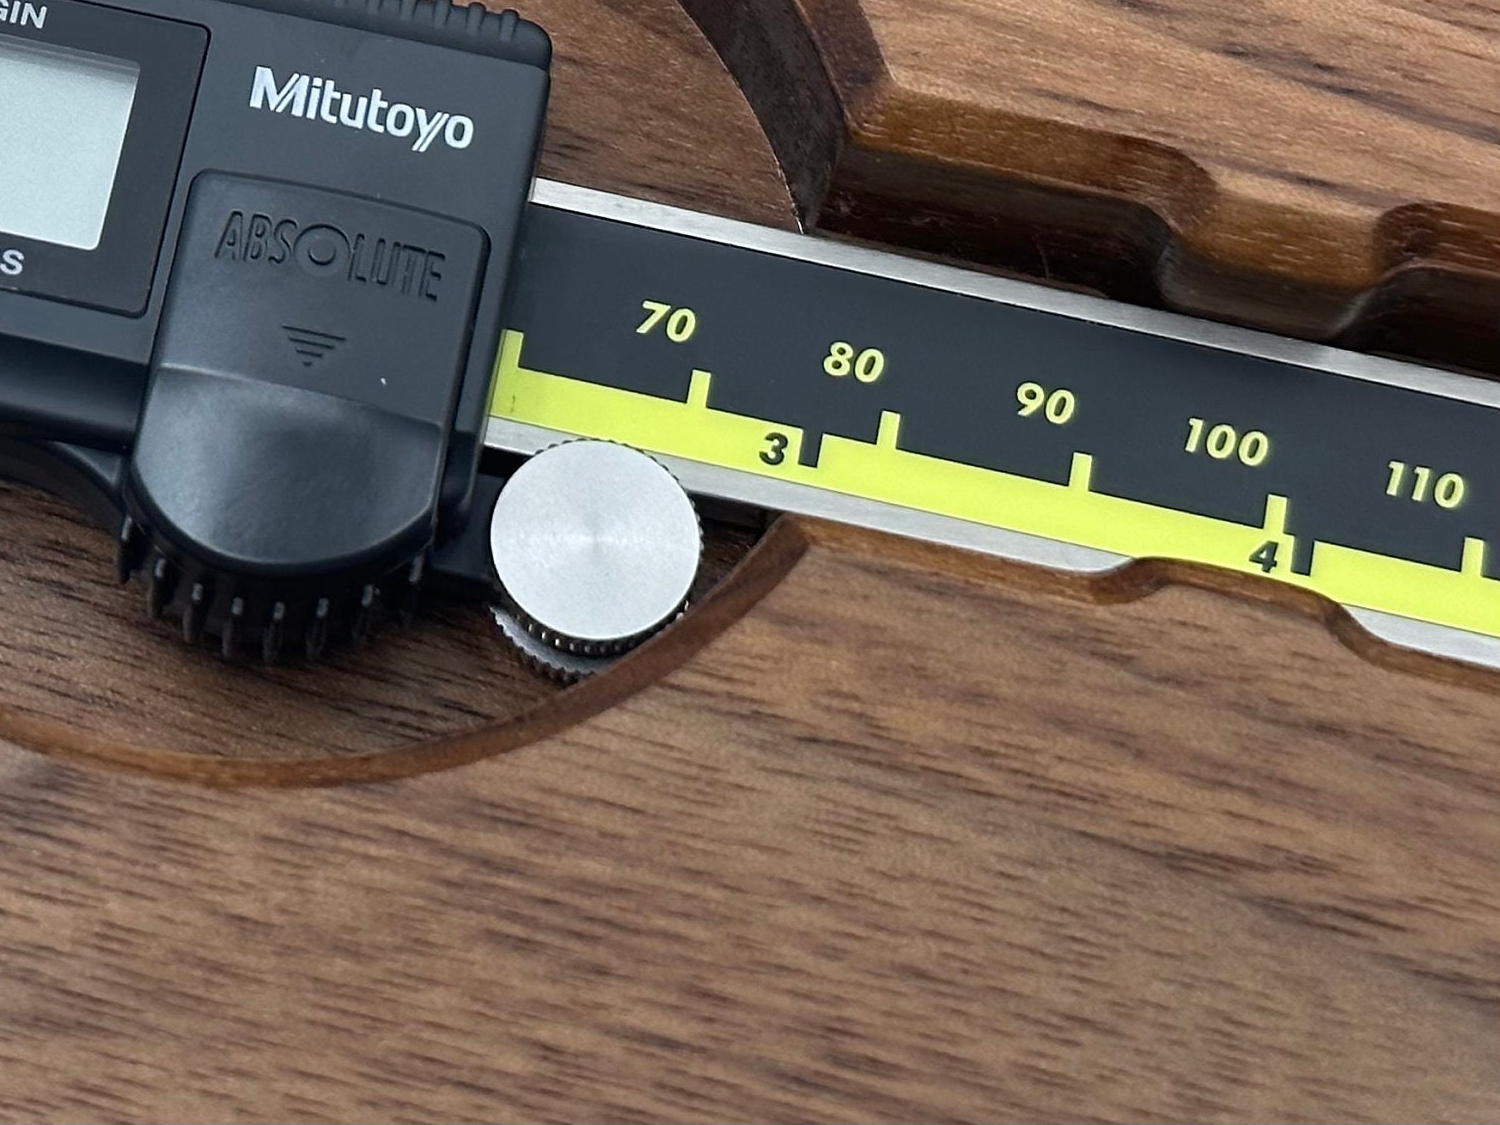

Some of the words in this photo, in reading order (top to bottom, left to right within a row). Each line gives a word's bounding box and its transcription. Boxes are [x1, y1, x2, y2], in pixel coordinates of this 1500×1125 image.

[249, 66, 474, 153] Mitutoyo
[214, 210, 446, 302] ABSOLUTE
[636, 300, 696, 343] 70
[823, 341, 885, 383] 80
[1016, 382, 1075, 425] 90
[1185, 418, 1269, 467] 100
[1386, 461, 1465, 509] 110
[758, 432, 789, 466] 3
[1248, 540, 1280, 574] 4
